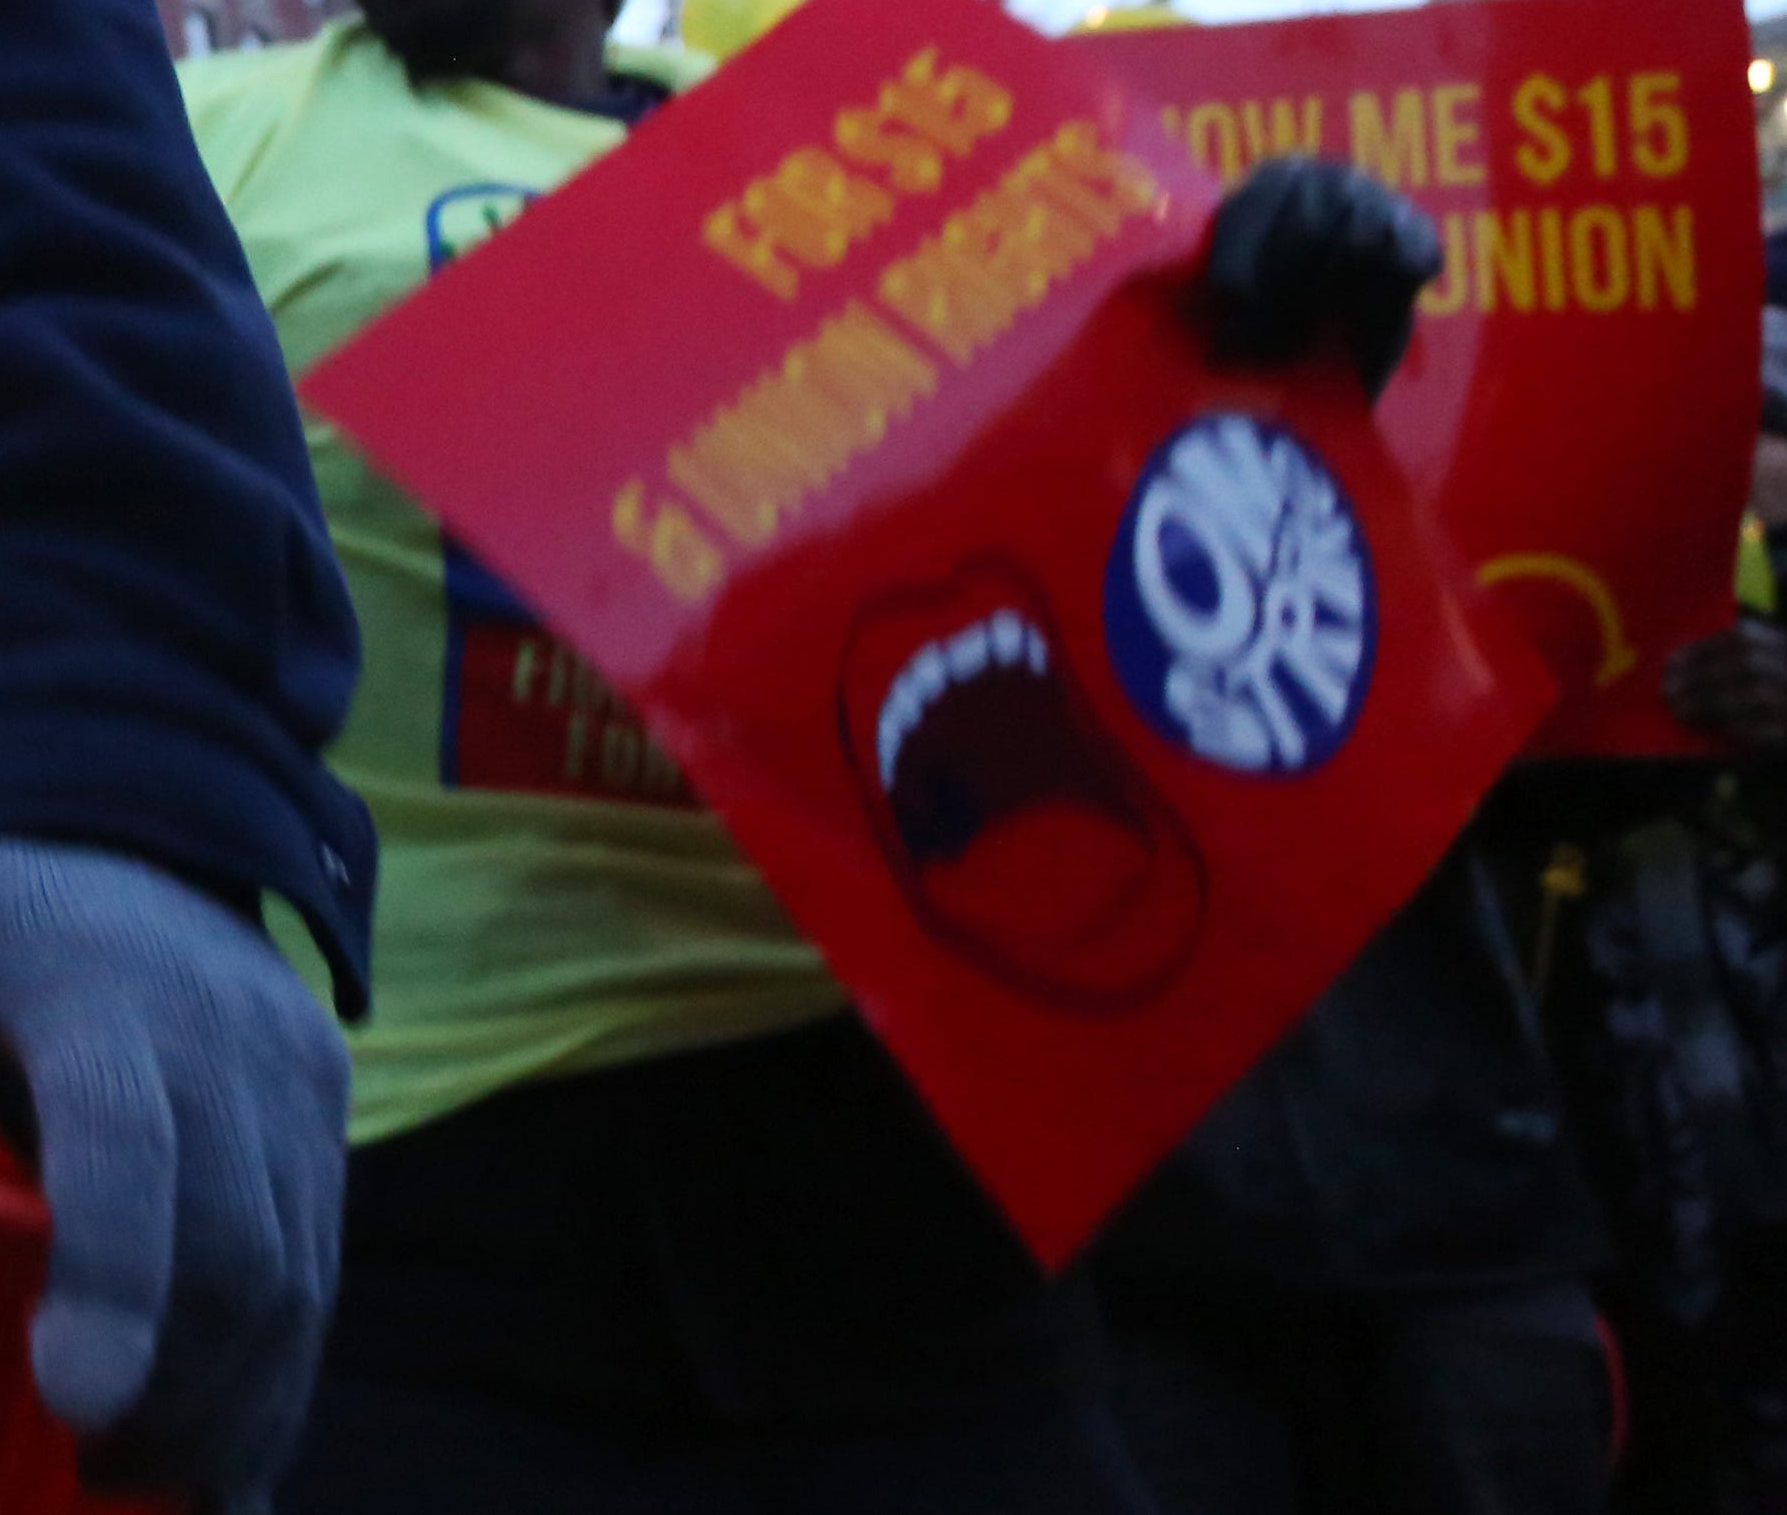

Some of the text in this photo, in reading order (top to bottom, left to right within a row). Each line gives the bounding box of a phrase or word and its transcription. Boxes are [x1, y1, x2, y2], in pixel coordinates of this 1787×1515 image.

[1347, 82, 1486, 189] ME
[1512, 72, 1689, 181] $15
[702, 144, 895, 304] FOR
